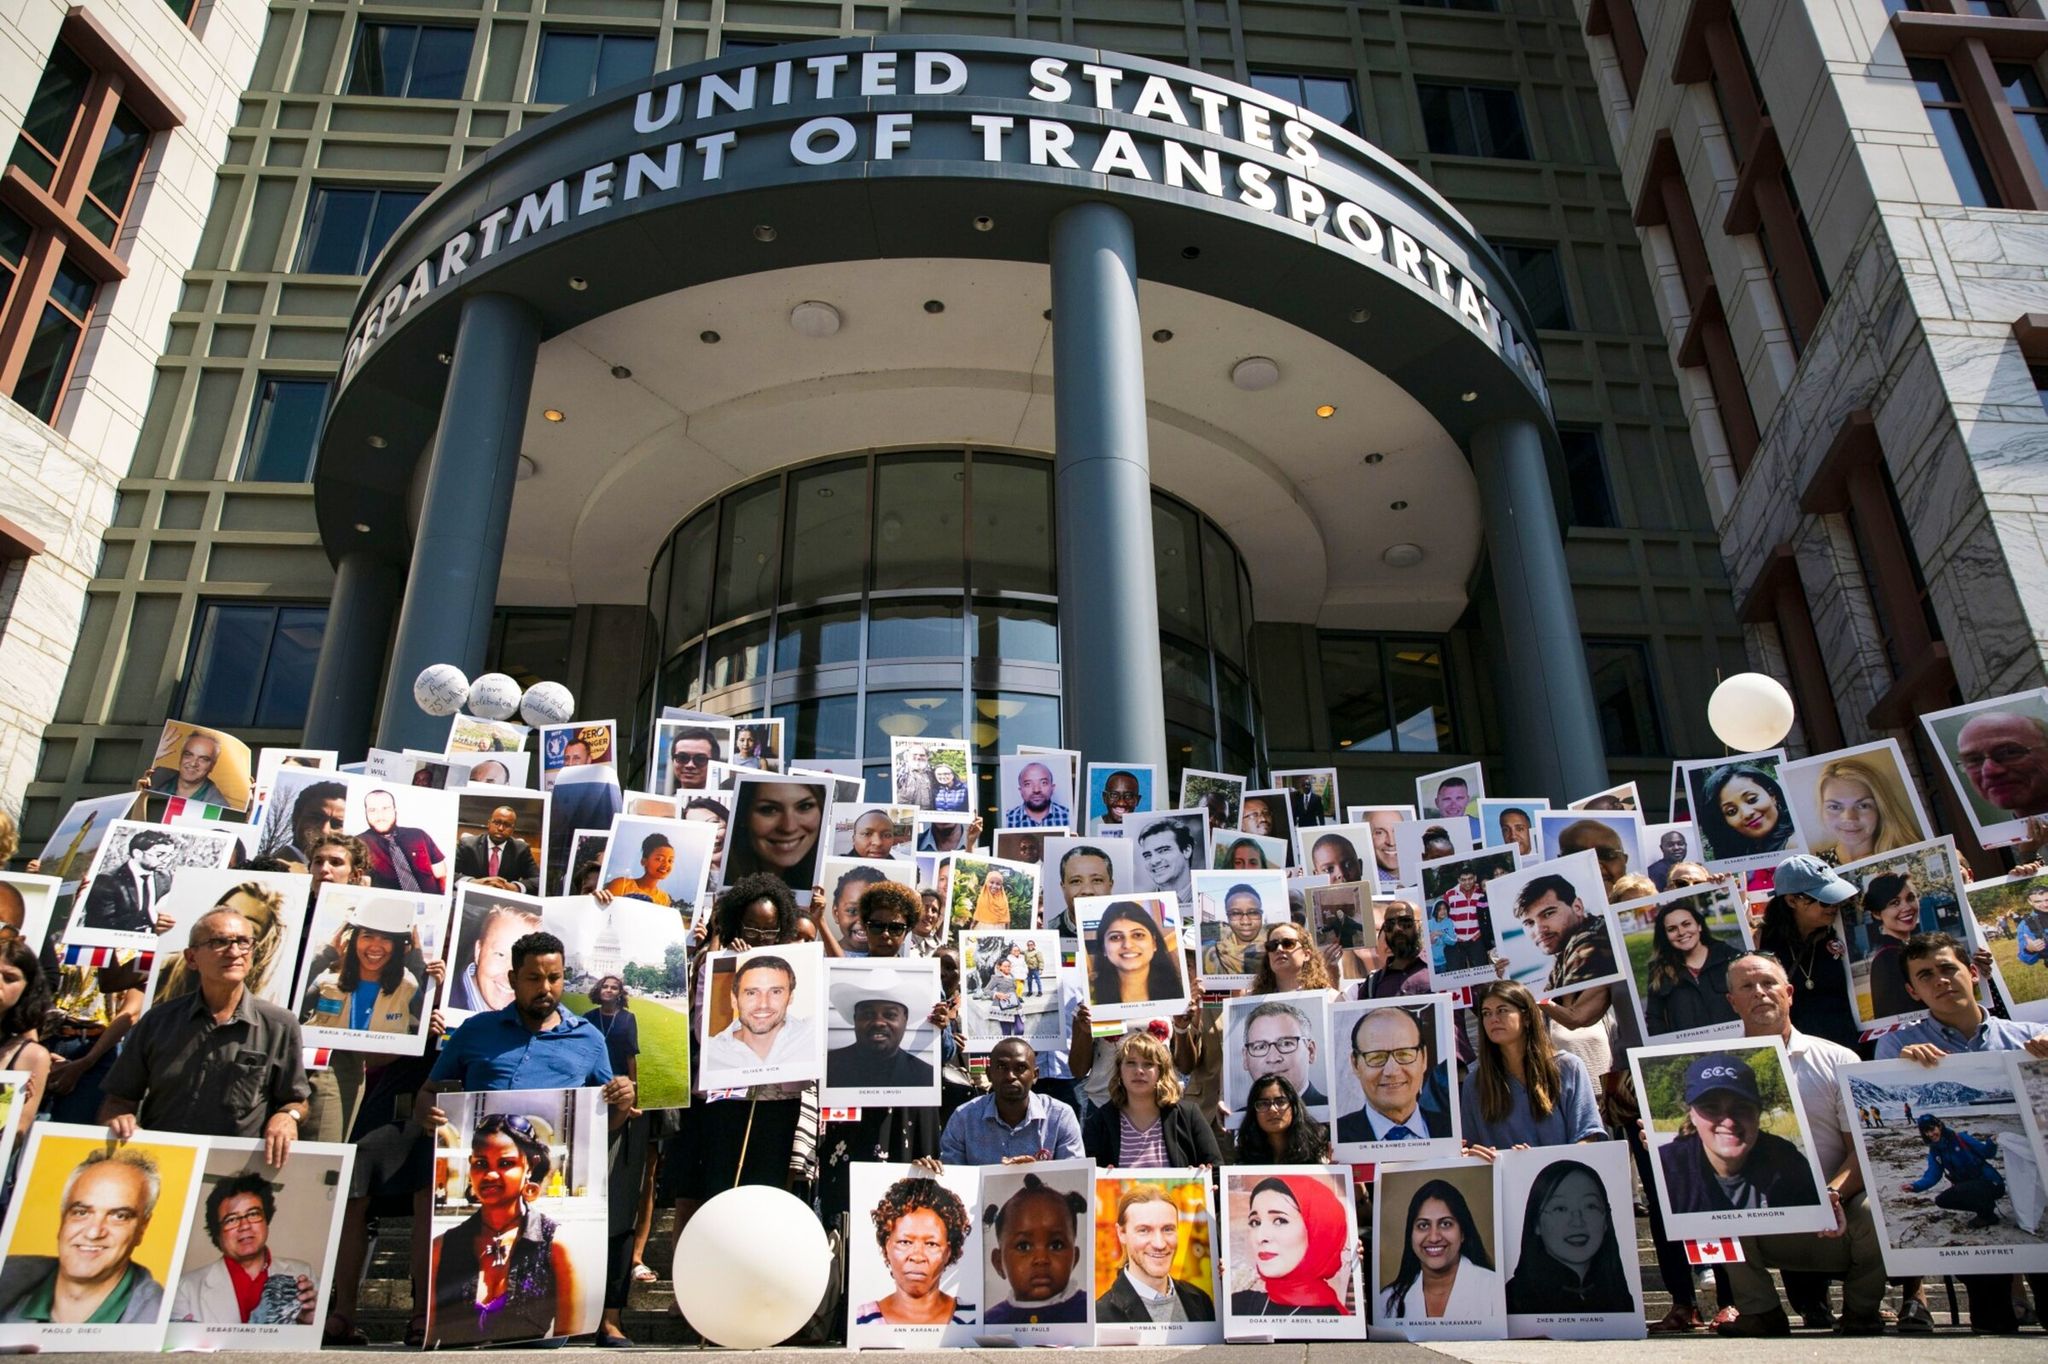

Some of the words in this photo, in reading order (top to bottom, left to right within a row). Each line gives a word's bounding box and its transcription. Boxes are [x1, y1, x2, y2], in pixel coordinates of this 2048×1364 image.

[633, 52, 968, 134] UNITED
[1029, 57, 1321, 169] STATES
[340, 131, 737, 390] DEPARTMENT
[790, 113, 912, 165] OF
[583, 727, 604, 739] ZERO
[371, 768, 387, 776] WILL
[1711, 1212, 1743, 1221] ANGELA
[1747, 1210, 1786, 1219] REHHORN
[1939, 1249, 1970, 1258] SARAH
[1974, 1247, 2015, 1257] AUFFRET
[206, 1326, 256, 1334] SEBASTIANO
